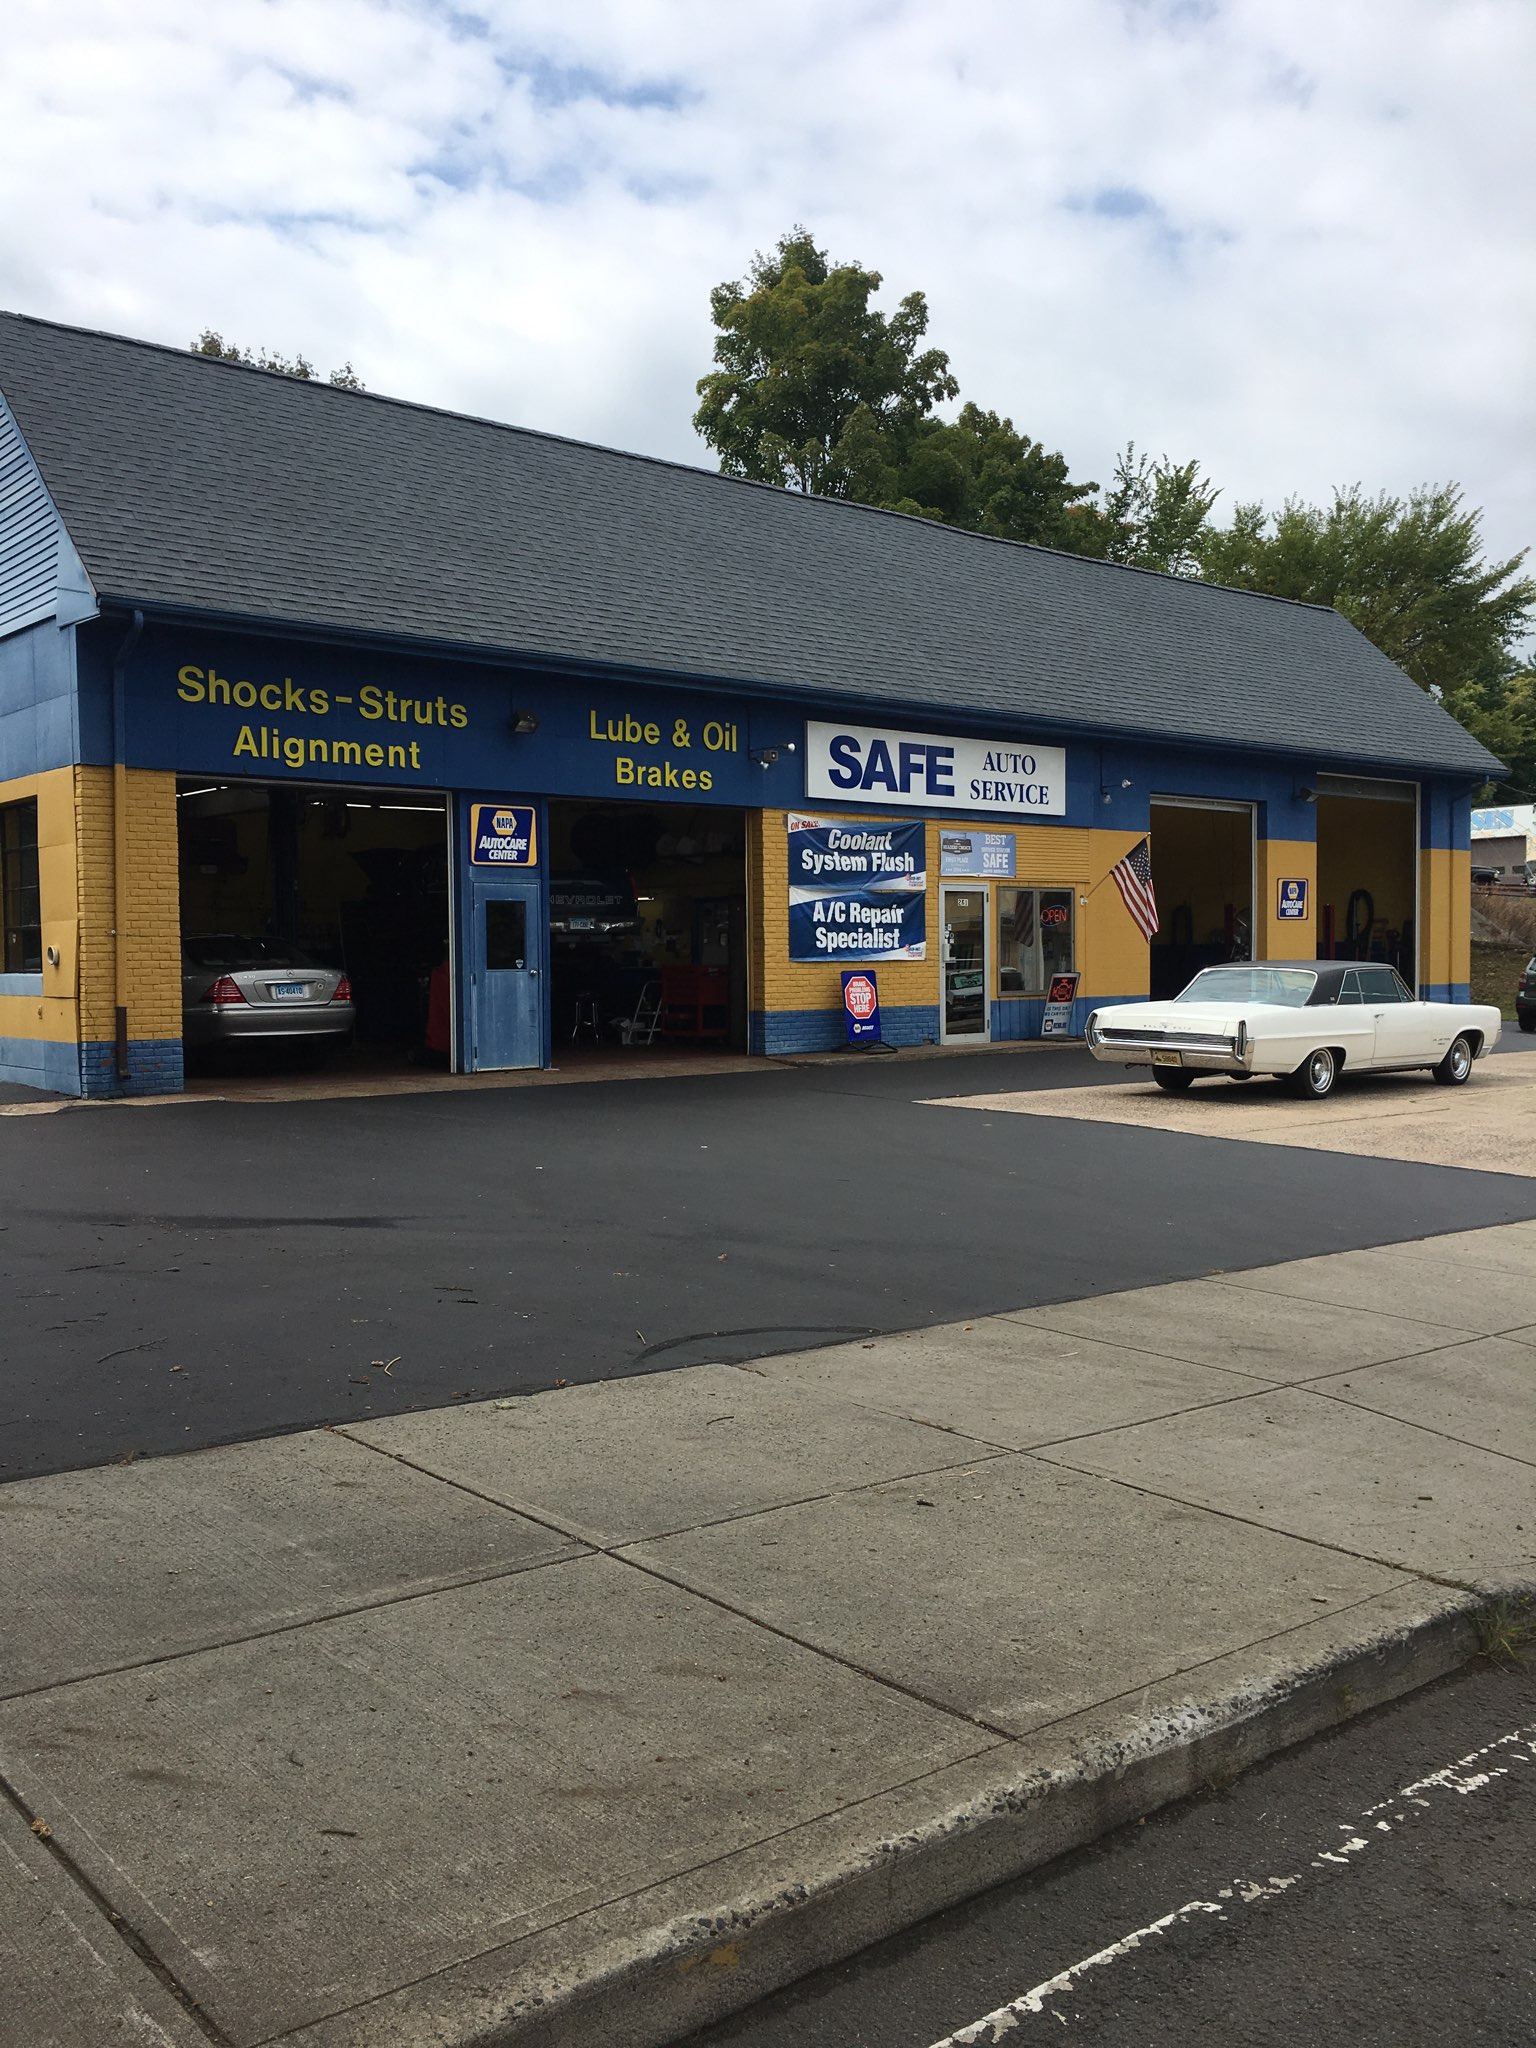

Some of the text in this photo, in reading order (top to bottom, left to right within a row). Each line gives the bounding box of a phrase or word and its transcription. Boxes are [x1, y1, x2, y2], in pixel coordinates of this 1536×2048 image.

[590, 710, 737, 752] Lube & Oil
[232, 725, 421, 769] Alignment
[616, 757, 713, 791] Brakes
[828, 735, 955, 797] SAFE
[982, 751, 1036, 776] AUTO
[970, 779, 1050, 805] SERVICE
[496, 817, 514, 829] NAPA
[828, 829, 892, 851] Coolant
[985, 834, 1007, 845] BEST
[488, 850, 518, 860] CENTER
[801, 848, 914, 874] System Flush
[983, 853, 1009, 868] SAFE
[547, 895, 623, 905] HEVROLET
[813, 901, 904, 928] A/C Repair
[1041, 909, 1066, 922] OPEN
[815, 927, 900, 953] Specialist
[850, 993, 871, 1005] STOP
[854, 1005, 870, 1013] HERE
